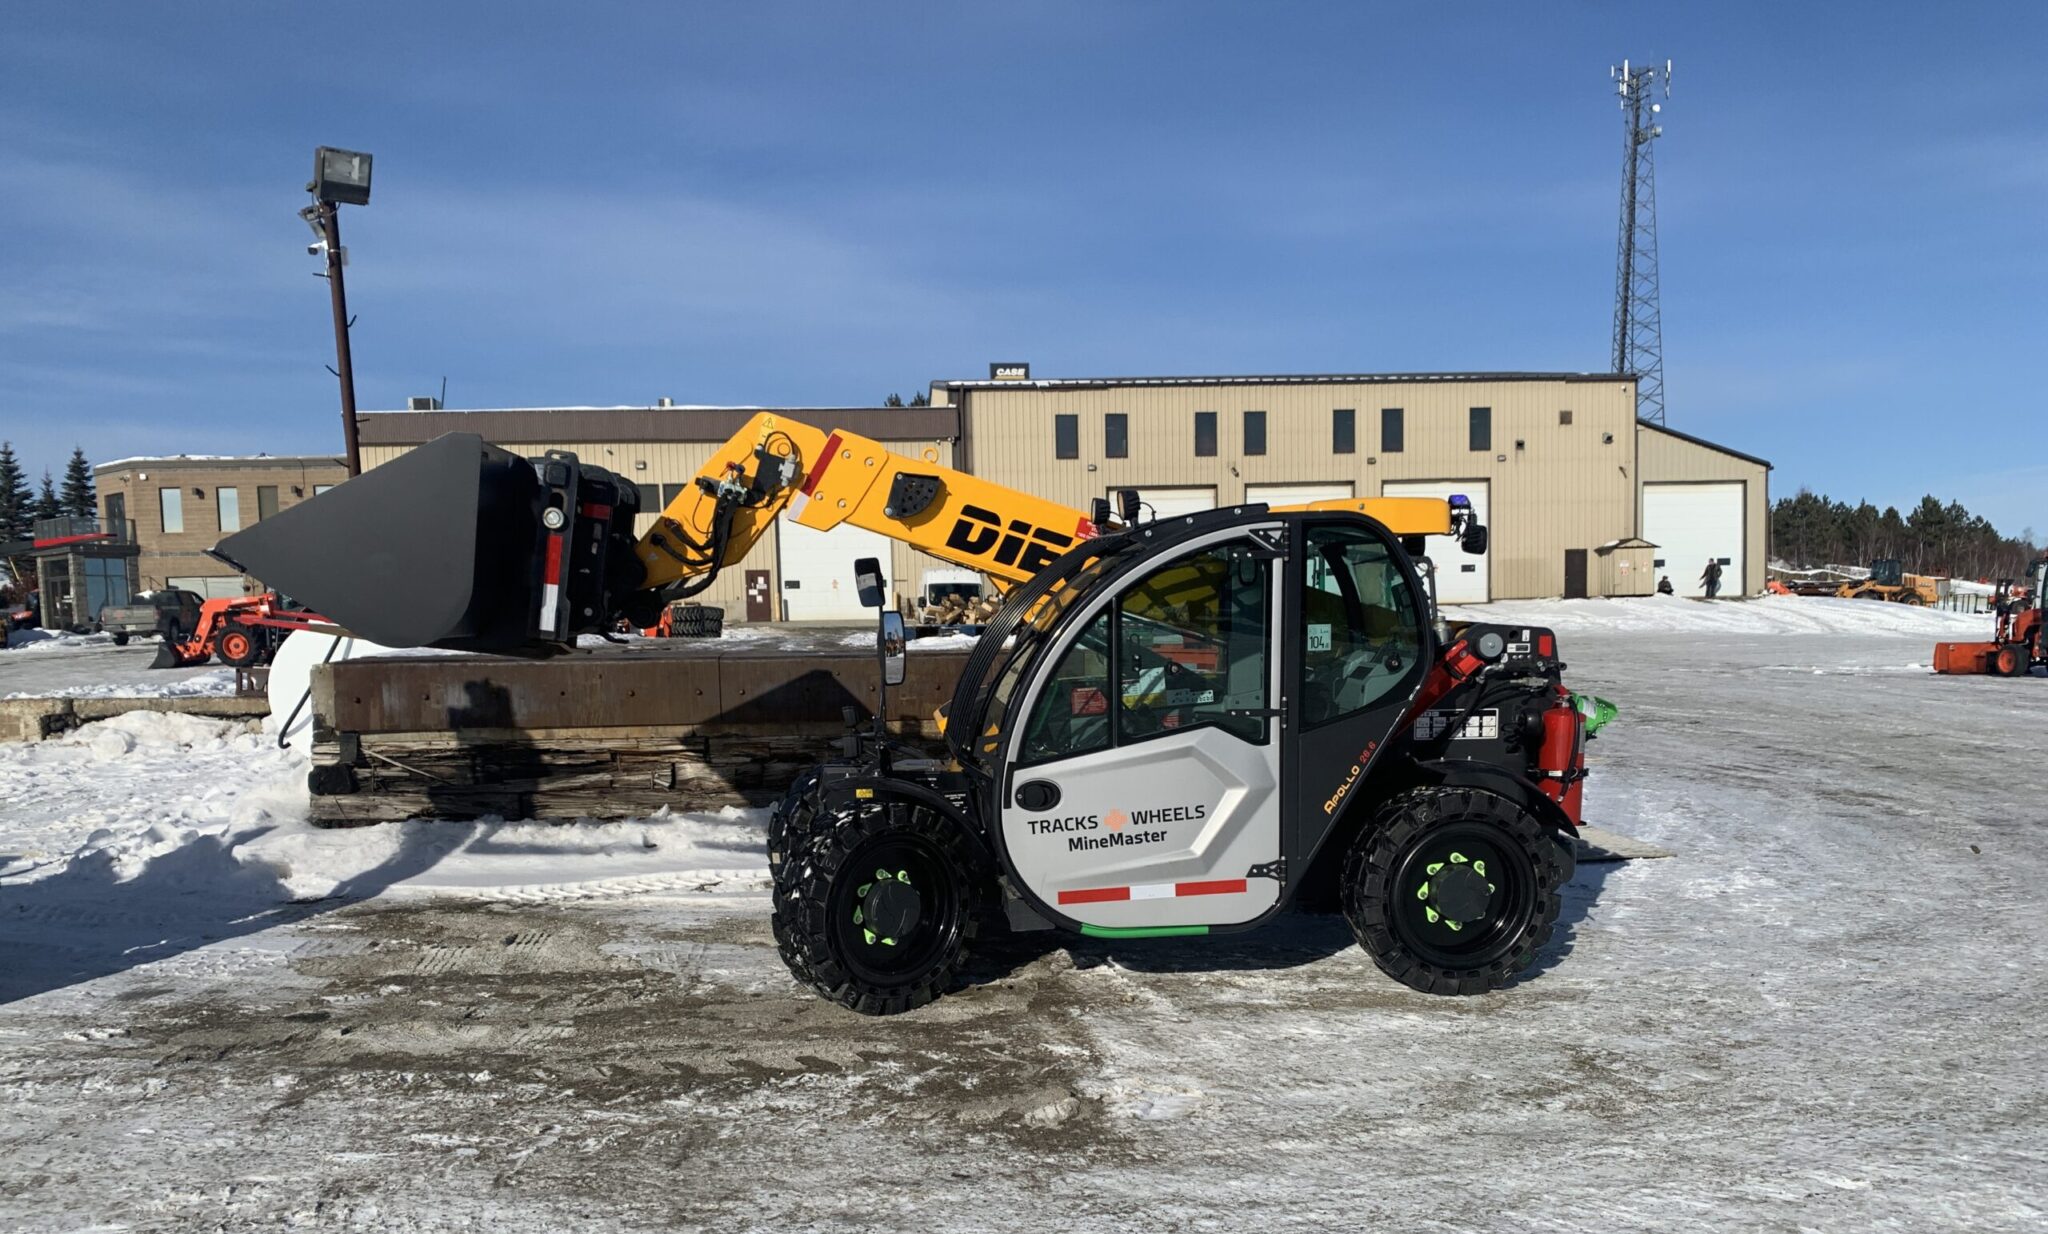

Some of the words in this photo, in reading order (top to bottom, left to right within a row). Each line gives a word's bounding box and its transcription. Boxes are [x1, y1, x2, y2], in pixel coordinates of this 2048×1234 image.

[996, 367, 1026, 376] CASE
[1309, 636, 1325, 649] 104
[1324, 765, 1360, 814] APOLLO
[1027, 815, 1098, 835] TRACKS
[1131, 805, 1206, 826] WHEELS
[1068, 830, 1168, 852] MineMaster
